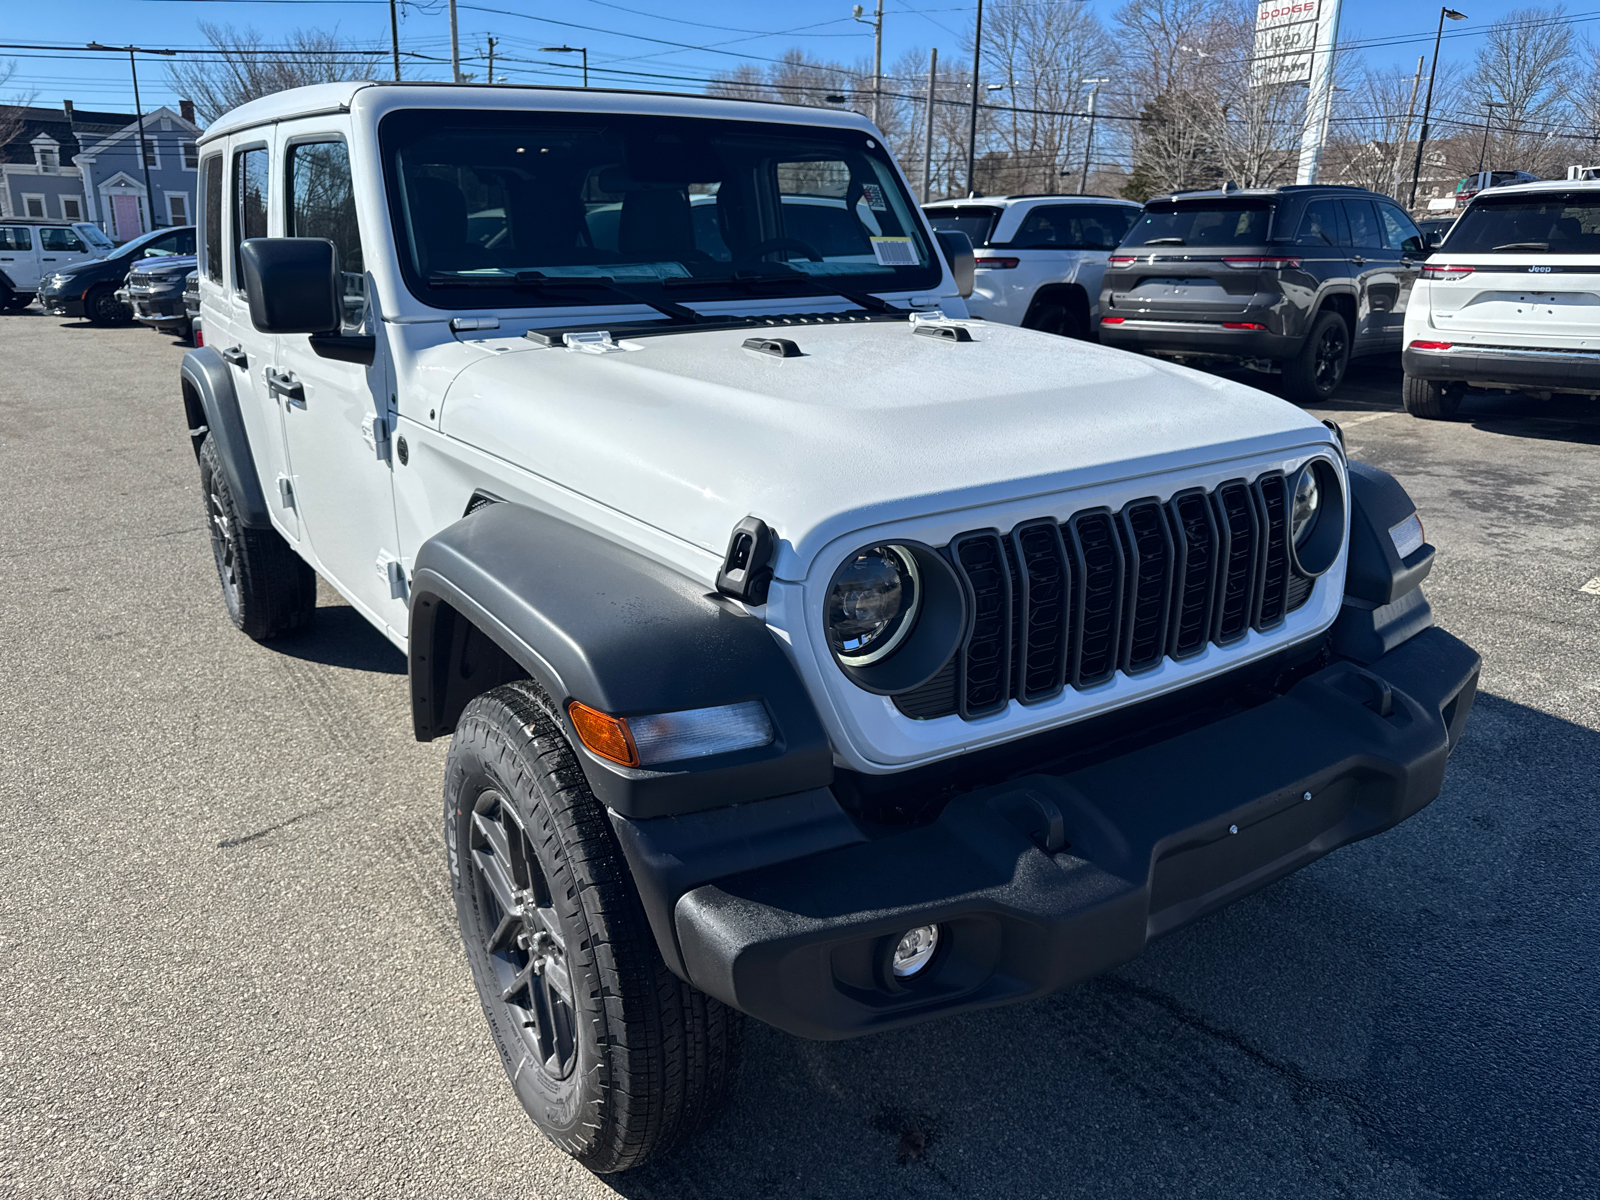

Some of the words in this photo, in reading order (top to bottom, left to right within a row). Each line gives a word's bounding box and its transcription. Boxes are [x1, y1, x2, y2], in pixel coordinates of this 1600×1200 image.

[1261, 2, 1314, 20] DODGE
[1265, 32, 1301, 49] Jeep
[1528, 265, 1552, 274] Jeep
